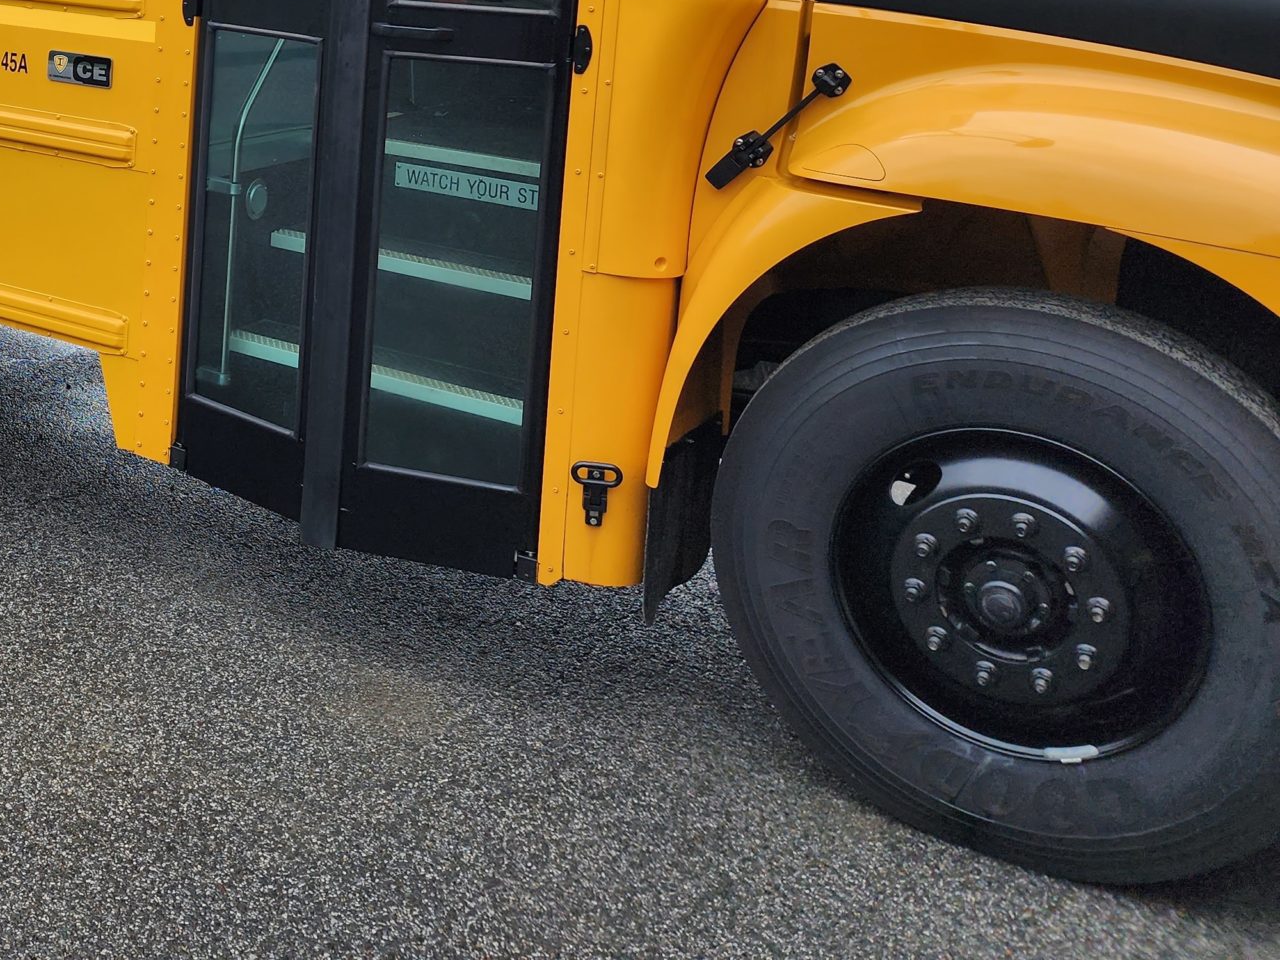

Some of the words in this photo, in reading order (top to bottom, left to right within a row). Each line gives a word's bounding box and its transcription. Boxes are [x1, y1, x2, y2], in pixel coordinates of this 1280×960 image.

[0, 51, 28, 74] 45A
[77, 62, 106, 81] CE
[406, 168, 460, 192] WATCH
[467, 178, 510, 201] YOUR
